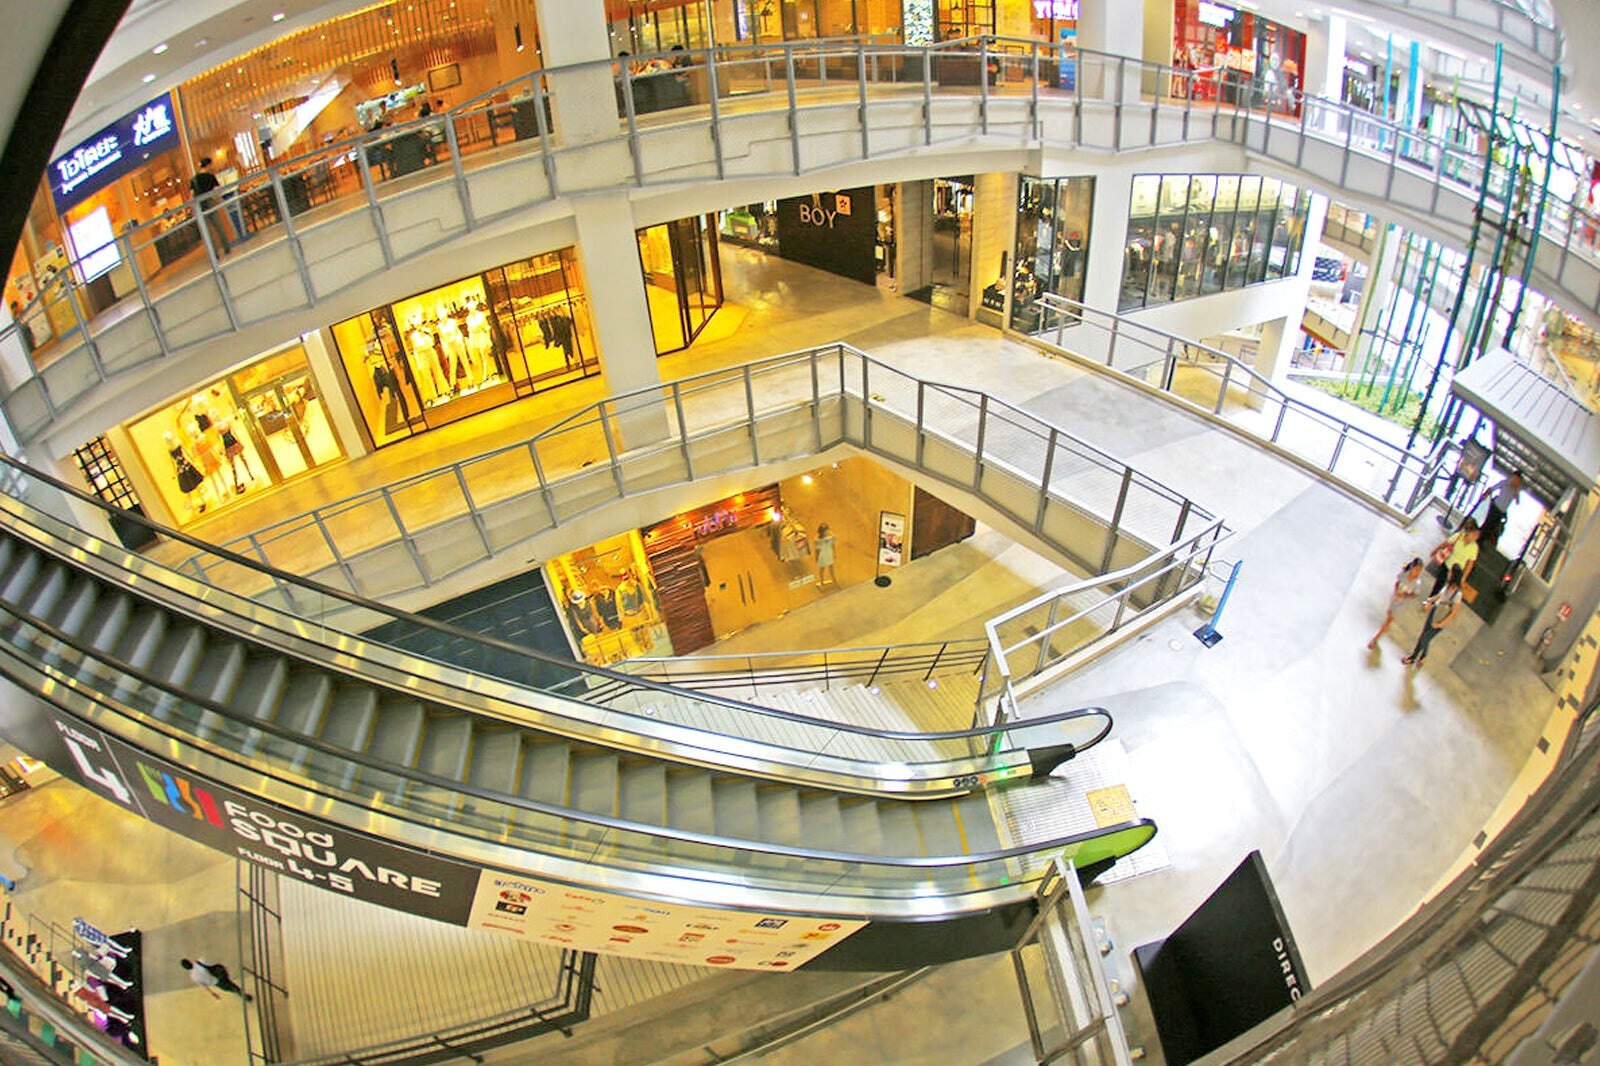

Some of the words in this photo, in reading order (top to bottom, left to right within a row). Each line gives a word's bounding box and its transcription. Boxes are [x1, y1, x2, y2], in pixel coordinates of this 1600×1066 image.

[799, 203, 837, 229] BOY
[65, 736, 131, 804] 4
[230, 818, 442, 897] SQUARE
